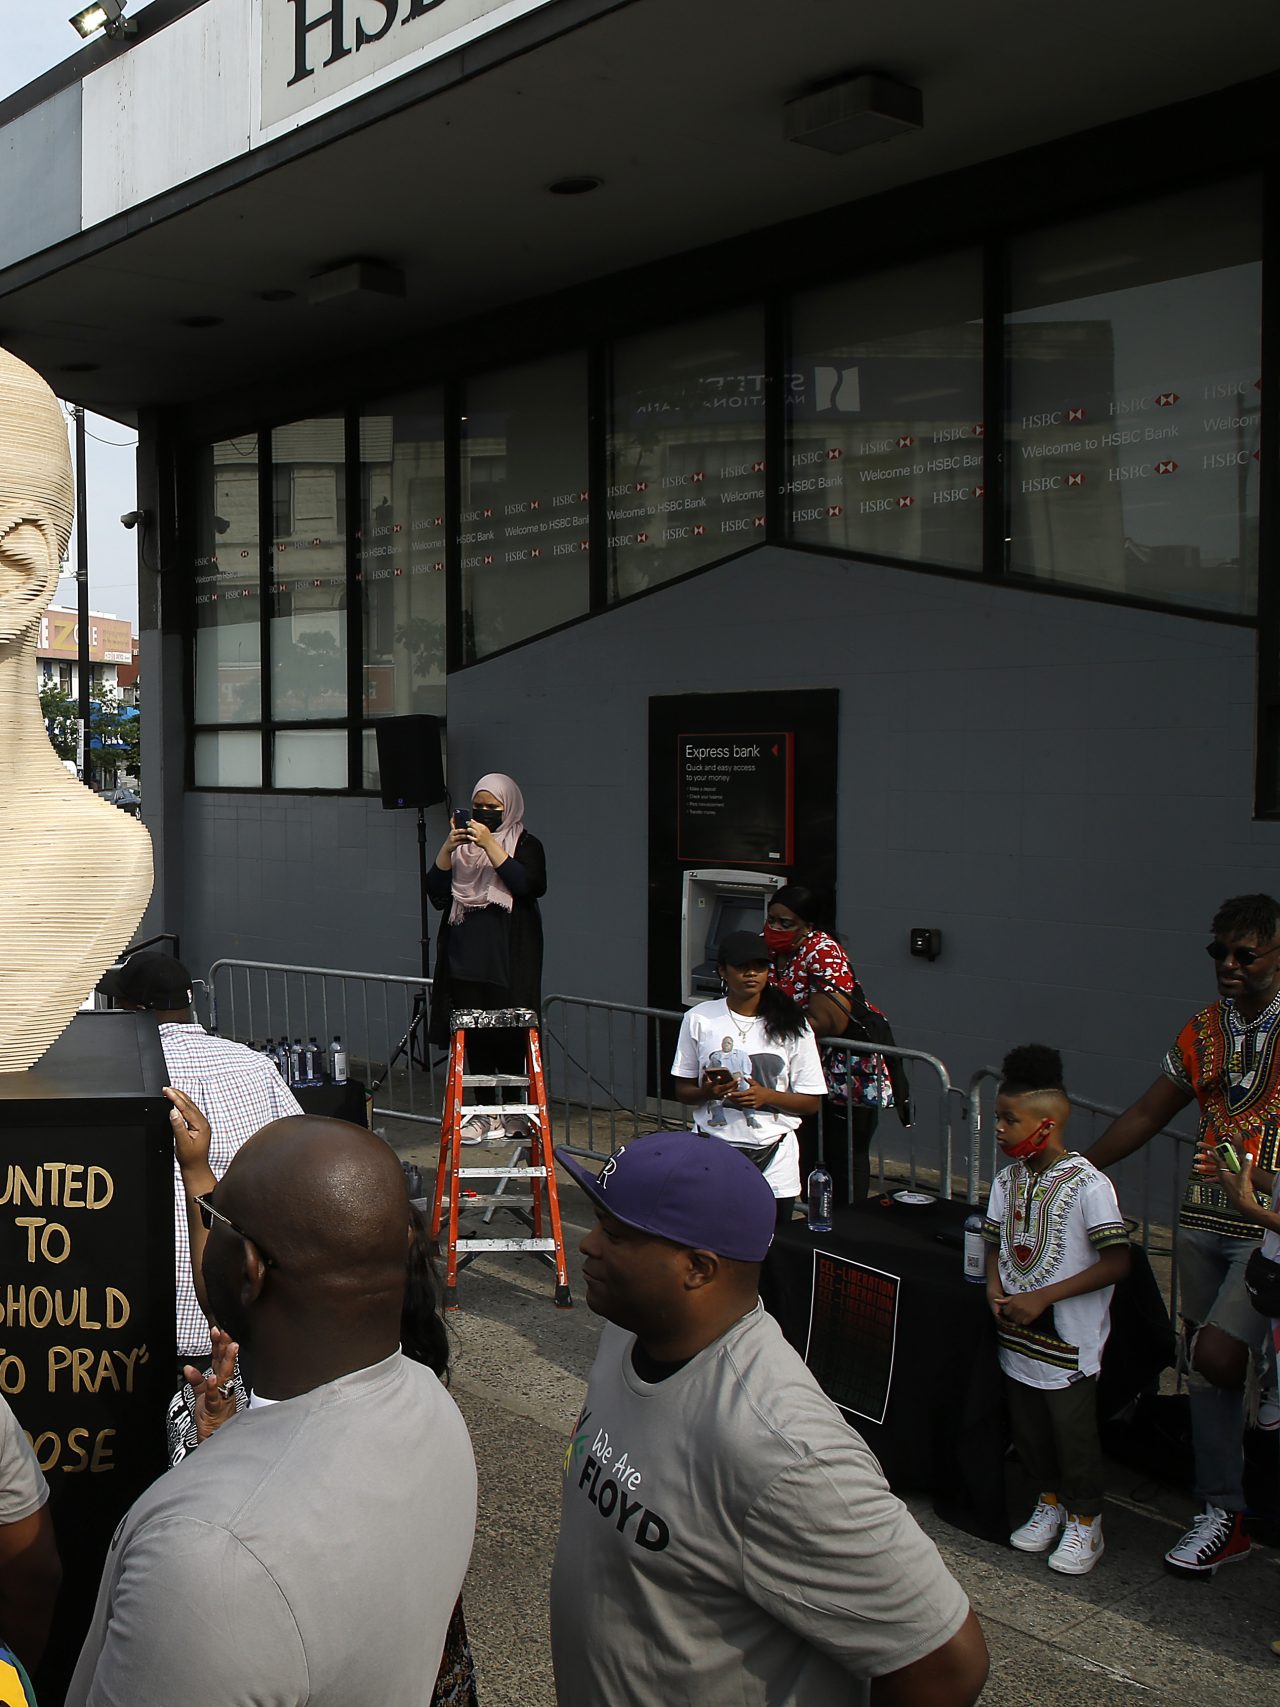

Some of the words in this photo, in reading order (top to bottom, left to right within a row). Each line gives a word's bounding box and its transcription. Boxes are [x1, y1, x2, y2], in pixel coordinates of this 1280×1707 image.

[1204, 380, 1248, 400] HSBC
[1109, 397, 1151, 415] HSBC
[1022, 411, 1061, 430] HSBC
[933, 426, 969, 444] HSBC
[1022, 439, 1082, 459] Welcome
[1085, 438, 1097, 450] to
[1102, 429, 1141, 447] HSBC
[1144, 425, 1180, 441] Bank
[792, 450, 823, 467] HSBC
[1203, 450, 1249, 470] HSBC
[721, 464, 749, 480] HSBC
[860, 465, 910, 483] Welcome
[913, 464, 924, 475] to
[927, 456, 960, 473] HSBC
[1108, 463, 1151, 481] HSBC
[661, 474, 689, 489] HSBC
[721, 489, 765, 504] Welcome
[787, 480, 816, 494] HSBC
[817, 476, 843, 490] Bank
[1021, 476, 1061, 494] HSBC
[607, 483, 632, 498] HSBC
[933, 487, 969, 505] HSBC
[505, 502, 529, 515] HSBC
[553, 494, 576, 508] HSBC
[607, 507, 646, 521] Welcome
[647, 505, 656, 515] to
[658, 499, 683, 514] HSBC
[685, 497, 706, 510] Bank
[860, 497, 893, 514] HSBC
[792, 507, 824, 523] HSBC
[372, 525, 390, 537] HSBC
[505, 525, 539, 538] Welcome
[540, 523, 548, 533] to
[548, 518, 572, 532] HSBC
[663, 526, 690, 541] HSBC
[721, 517, 751, 533] HSBC
[412, 539, 440, 552] Welcome
[477, 530, 495, 542] Bank
[553, 542, 577, 556] HSBC
[607, 533, 633, 548] HSBC
[460, 557, 481, 569] HSBC
[505, 550, 528, 563] HSBC
[372, 568, 391, 581] HSBC
[412, 563, 432, 575] HSBC
[686, 744, 730, 760] Express
[733, 744, 760, 758] bank
[686, 763, 703, 771] Quick
[717, 764, 732, 773] easy
[16, 1217, 71, 1265] TO
[23, 1427, 117, 1473] OSE
[592, 1428, 613, 1464] We
[612, 1452, 642, 1491] Are
[578, 1454, 670, 1552] FLOYD
